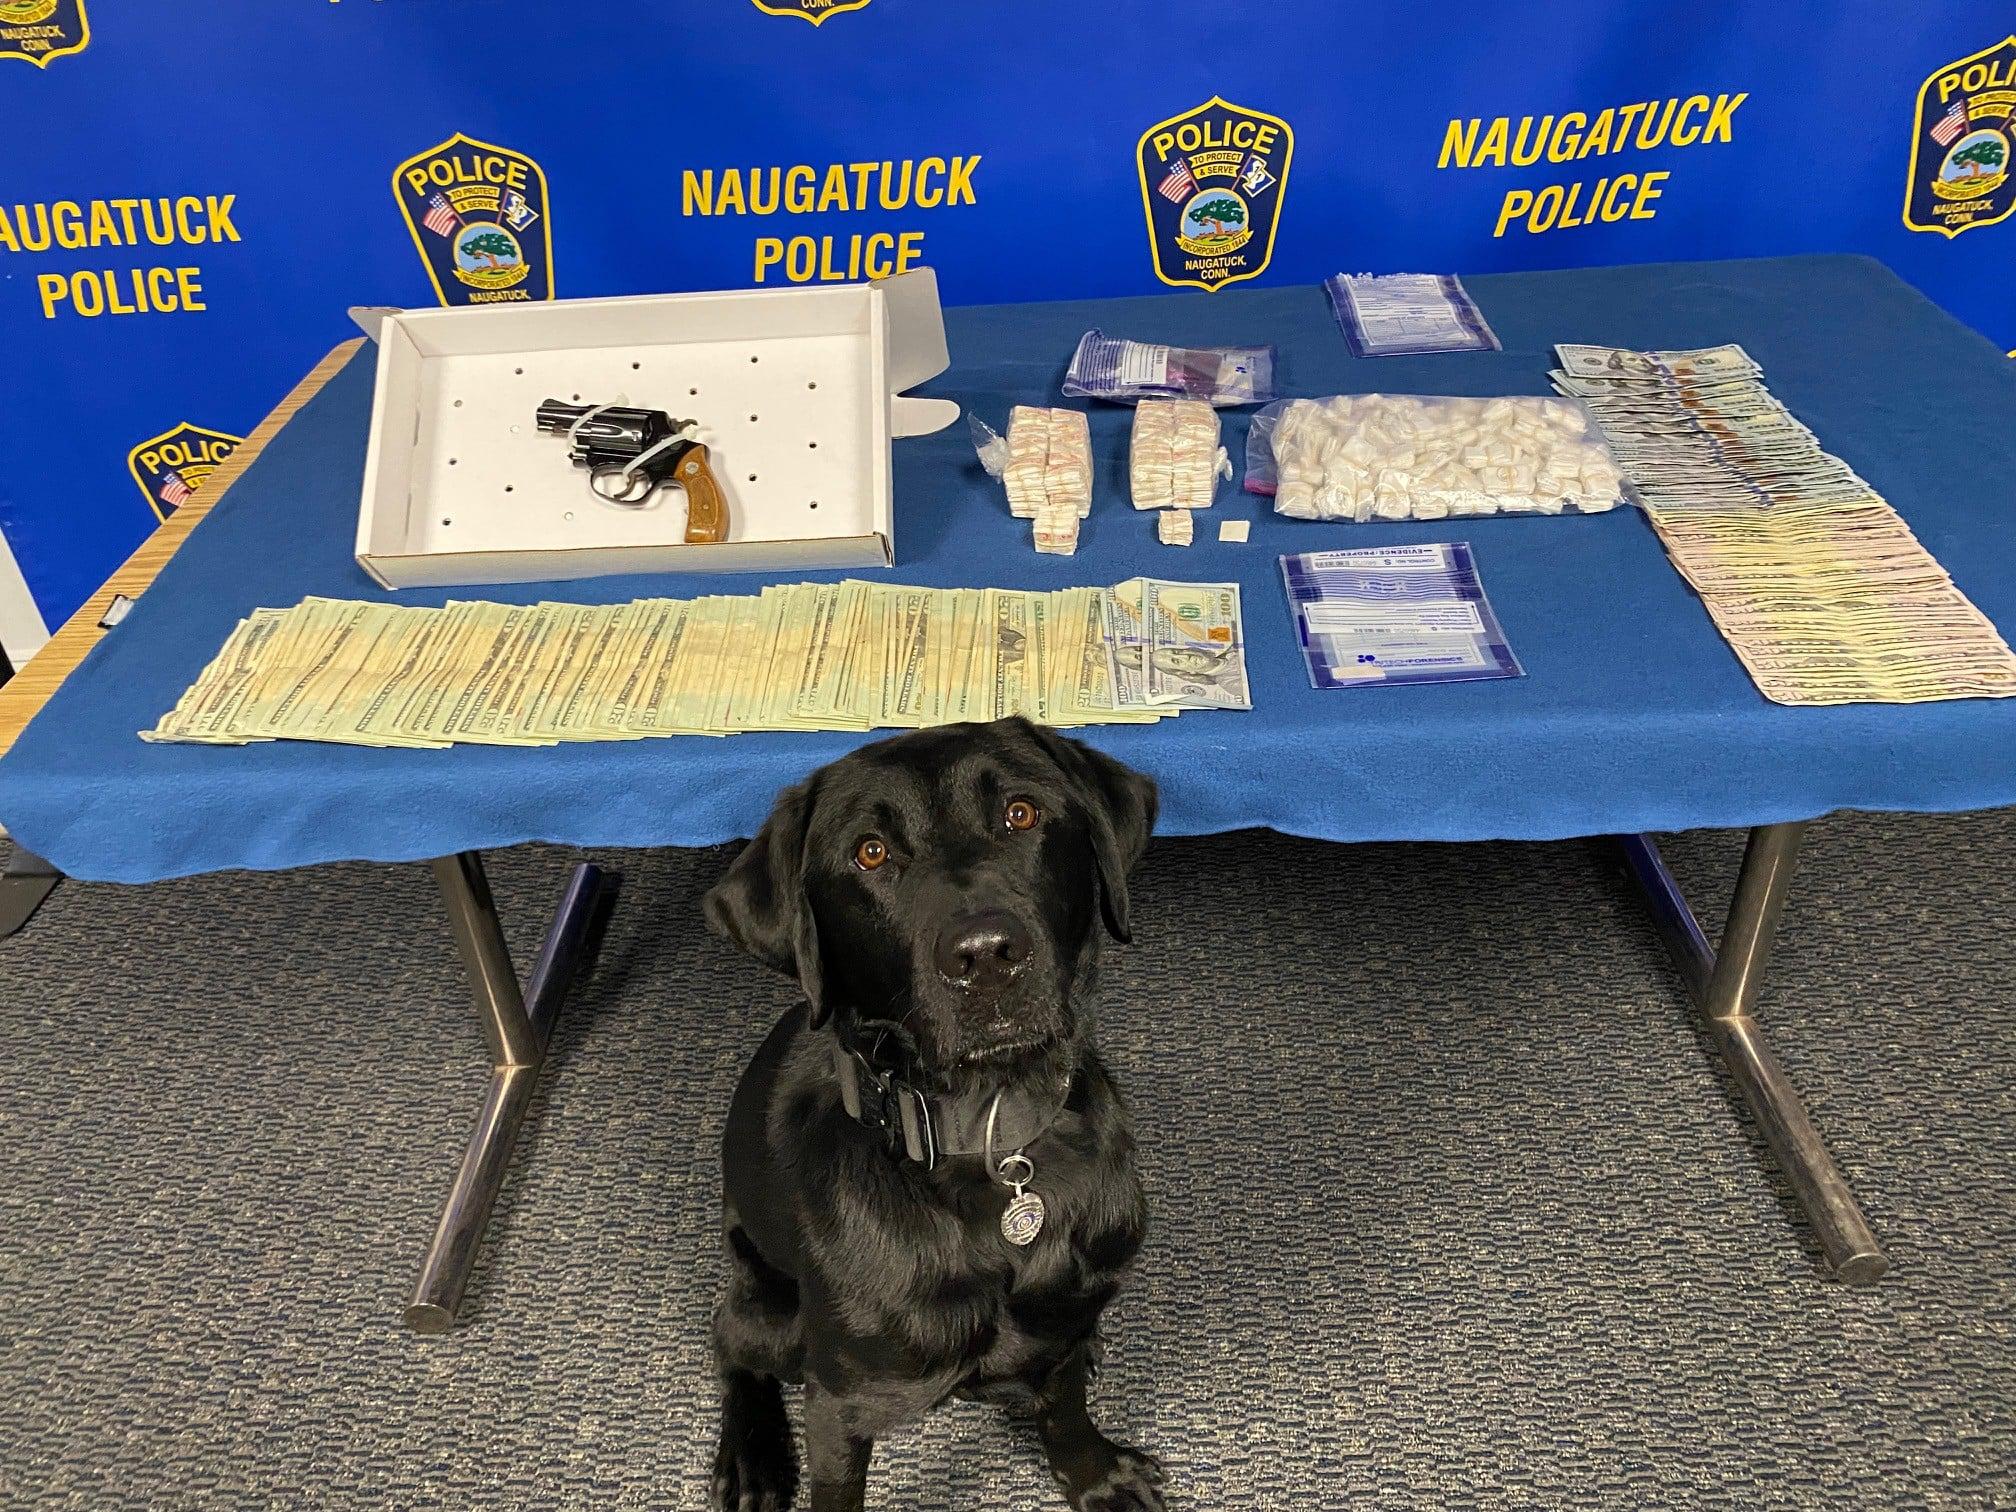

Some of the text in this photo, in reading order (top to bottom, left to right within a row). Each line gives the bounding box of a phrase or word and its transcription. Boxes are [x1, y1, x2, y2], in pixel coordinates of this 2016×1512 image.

[1153, 120, 1279, 162] POLICE
[1436, 92, 1748, 169] NAUGATUCK
[1193, 152, 1242, 165] TO PROTECT
[1207, 165, 1234, 174] SERVE
[406, 155, 529, 197] POLICE
[682, 155, 983, 217] NAUGATUCK
[463, 186, 498, 196] PROTECT
[1494, 171, 1670, 237] POLICE
[754, 232, 925, 283] POLICE
[1201, 267, 1231, 280] CONN.
[38, 267, 207, 319] POLICE
[998, 596, 1009, 620] 20
[1150, 588, 1158, 605] 100
[1220, 593, 1231, 617] 100
[1078, 688, 1090, 707] 20
[1118, 686, 1128, 703] 100
